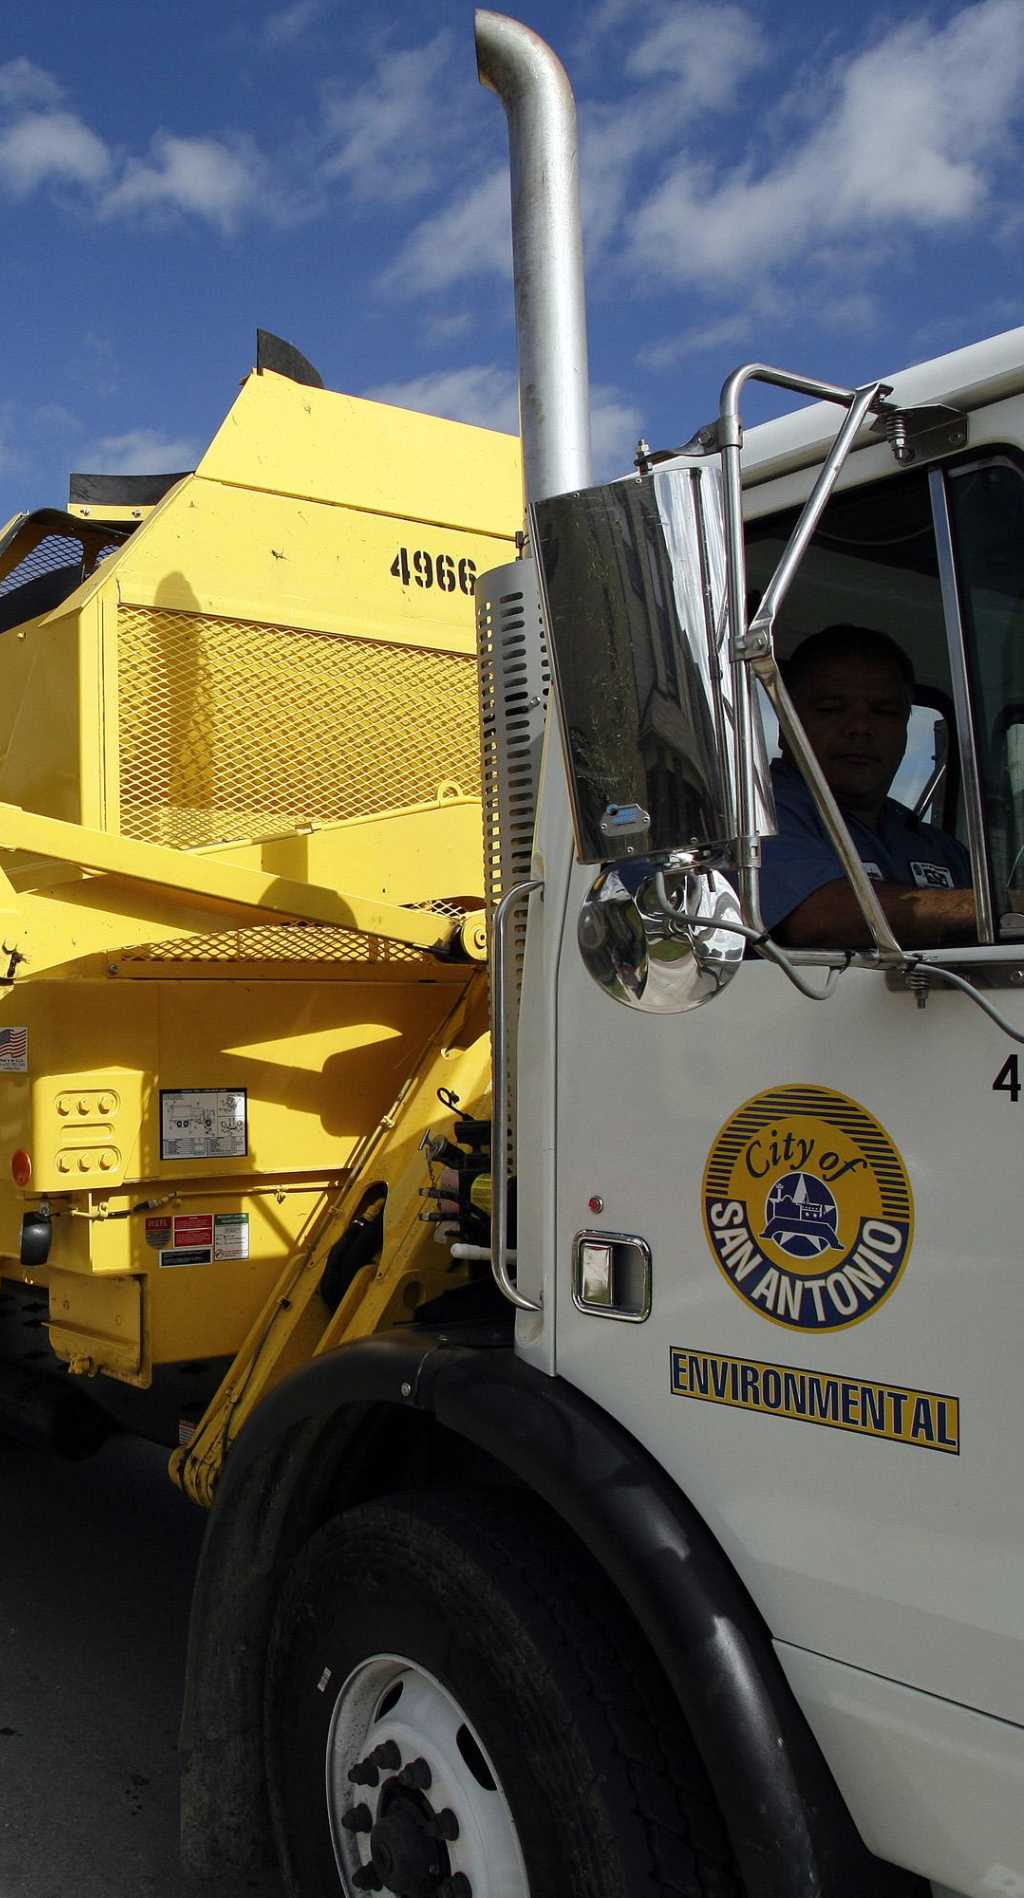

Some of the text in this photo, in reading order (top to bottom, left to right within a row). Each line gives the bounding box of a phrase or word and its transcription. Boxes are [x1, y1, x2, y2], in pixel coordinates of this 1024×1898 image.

[390, 547, 477, 596] 4966
[992, 1054, 1022, 1102] 4
[745, 1130, 868, 1182] City of
[711, 1201, 903, 1322] SAN ANTONIO
[672, 1352, 958, 1447] ENVIRONMENTAL
